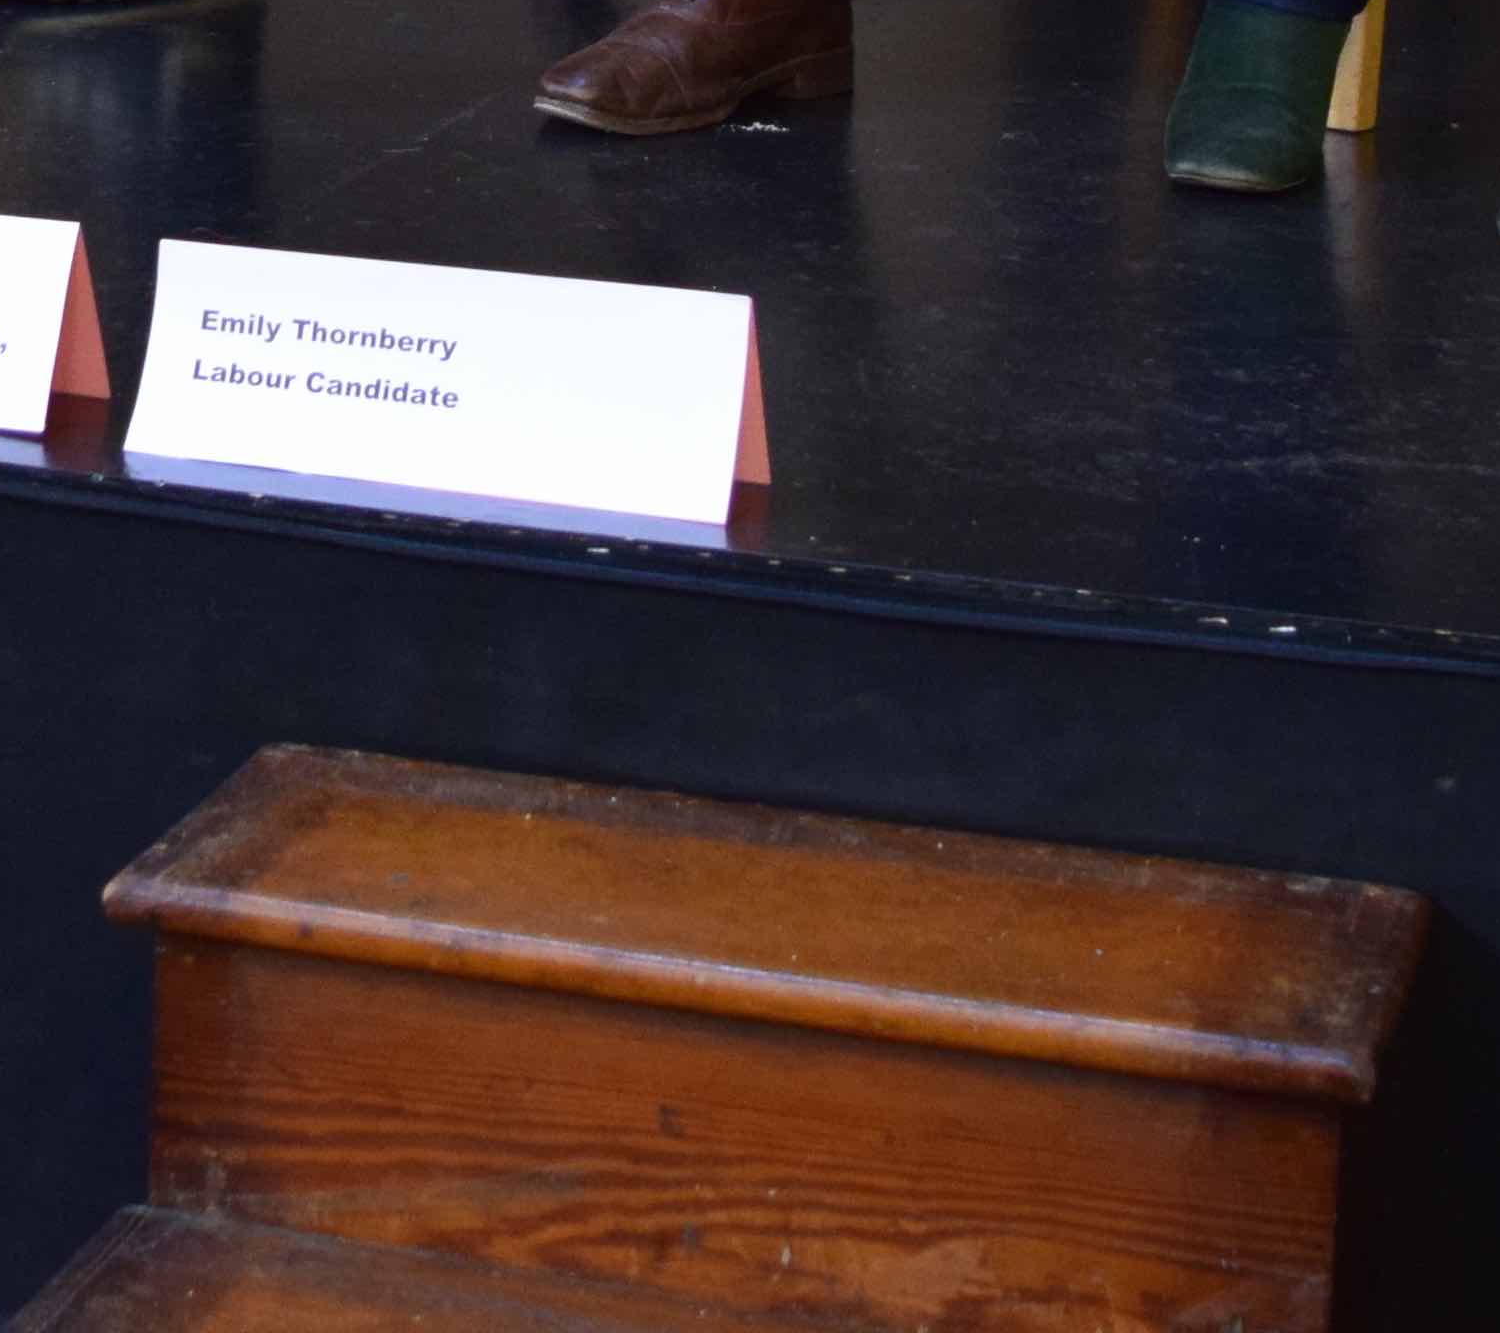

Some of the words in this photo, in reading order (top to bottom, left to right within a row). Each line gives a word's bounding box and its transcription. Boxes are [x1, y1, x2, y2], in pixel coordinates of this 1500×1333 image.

[200, 308, 283, 344] Emily
[291, 318, 458, 362] Thornberry
[192, 358, 297, 391] Labour
[305, 371, 460, 409] Candidate
